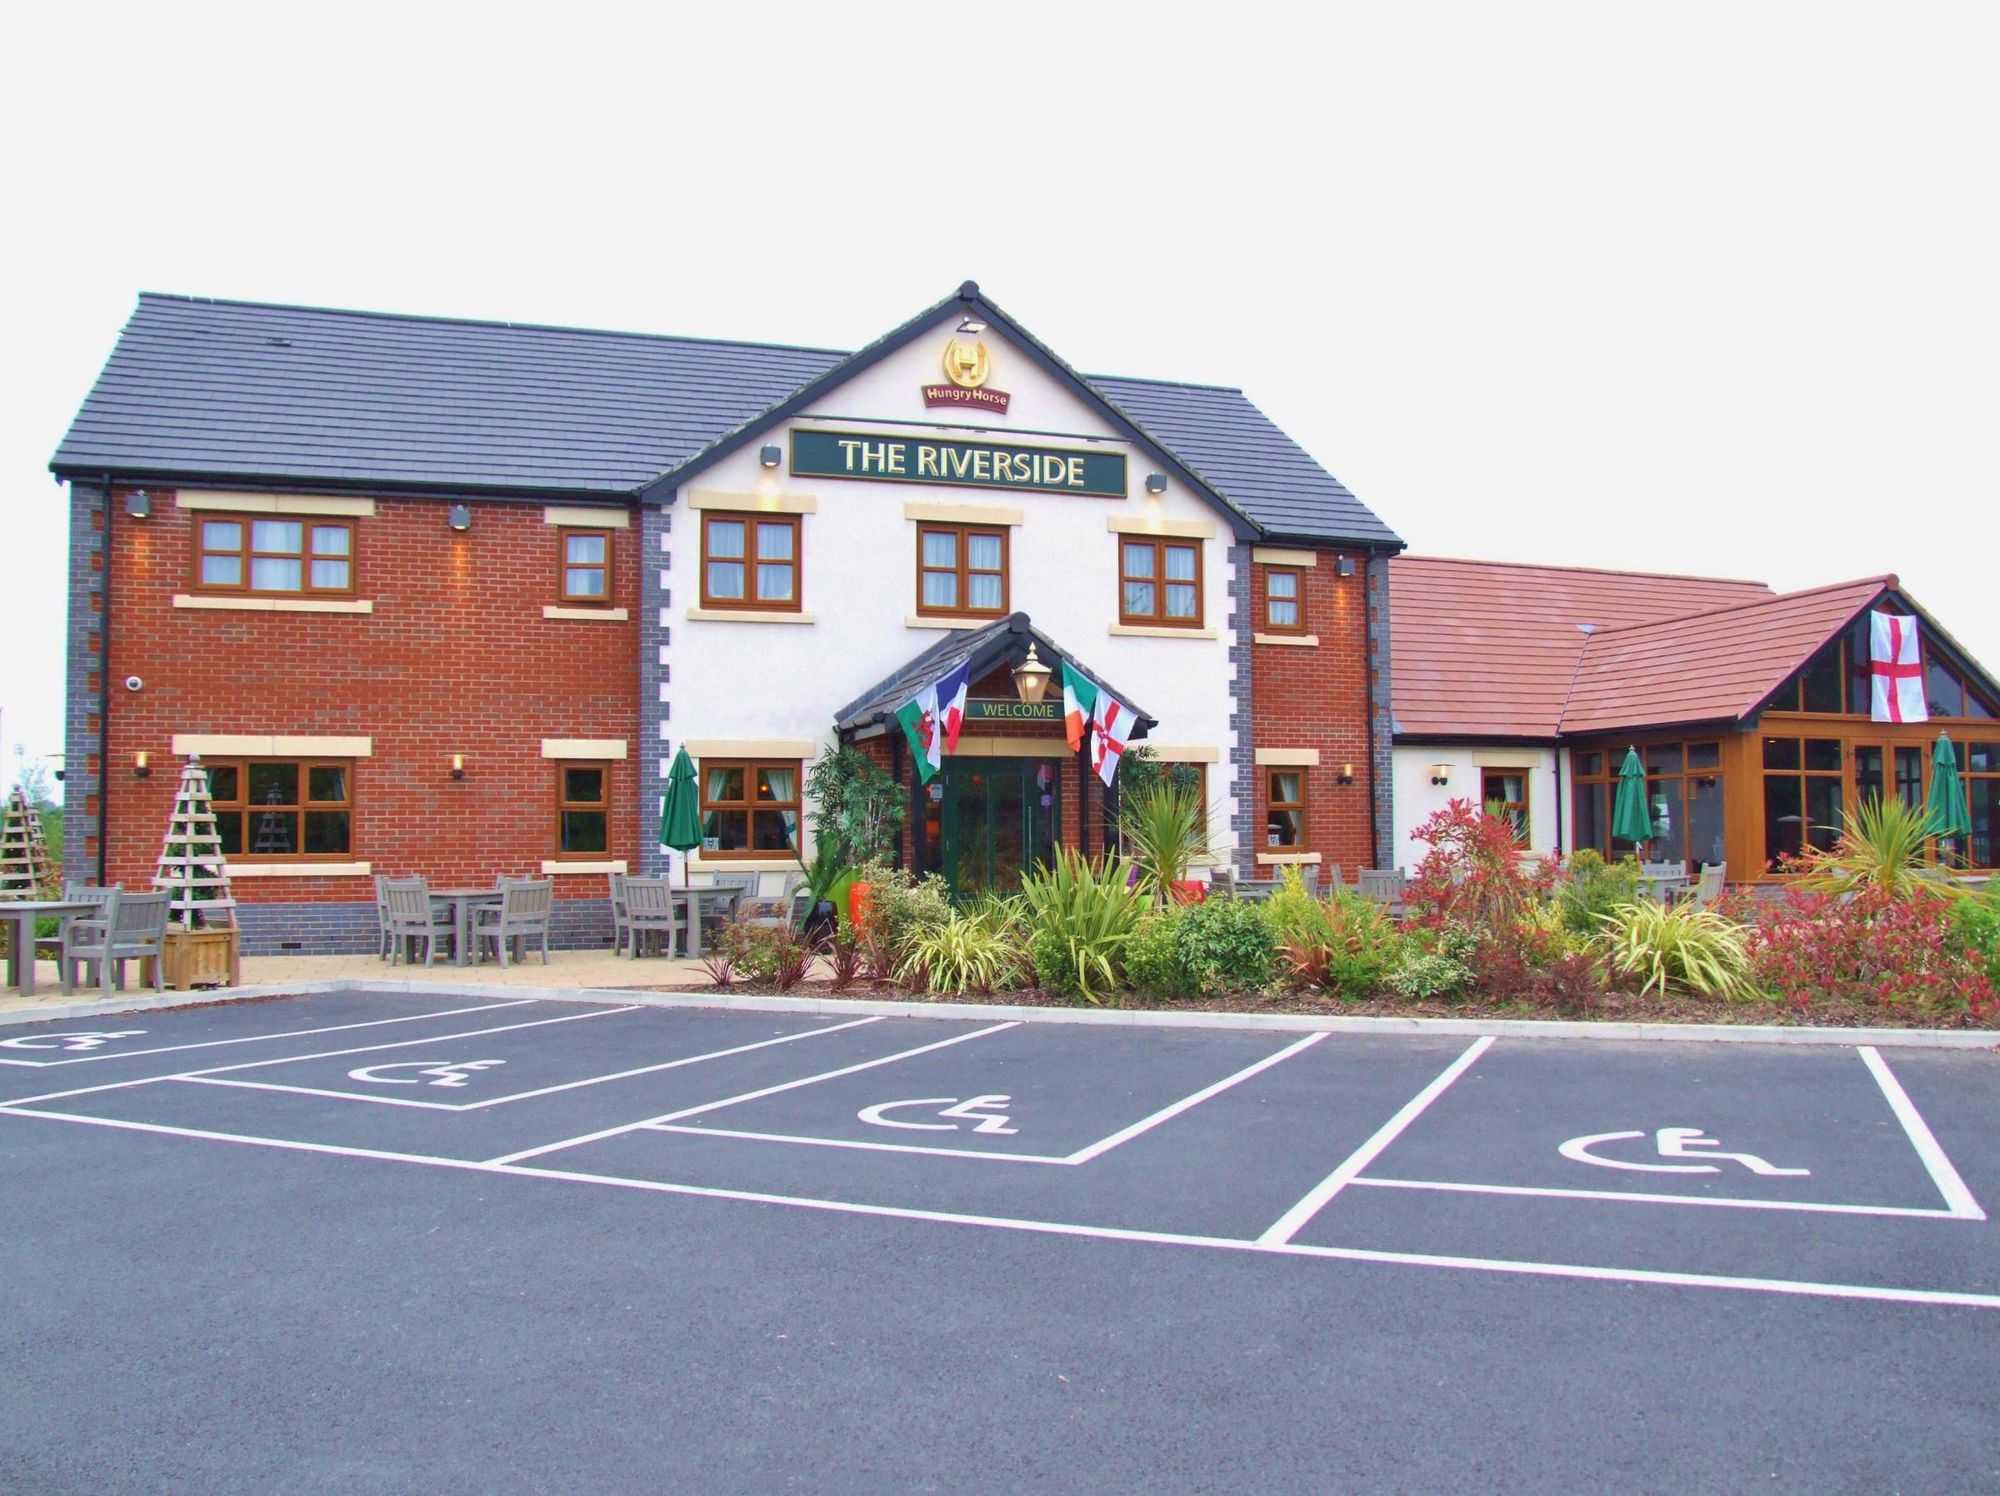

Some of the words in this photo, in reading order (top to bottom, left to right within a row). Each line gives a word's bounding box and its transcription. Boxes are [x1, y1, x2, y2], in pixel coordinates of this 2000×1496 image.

[838, 440, 906, 474] THE
[918, 445, 1085, 487] RIVERSIDE
[982, 703, 1054, 718] WELCOME
